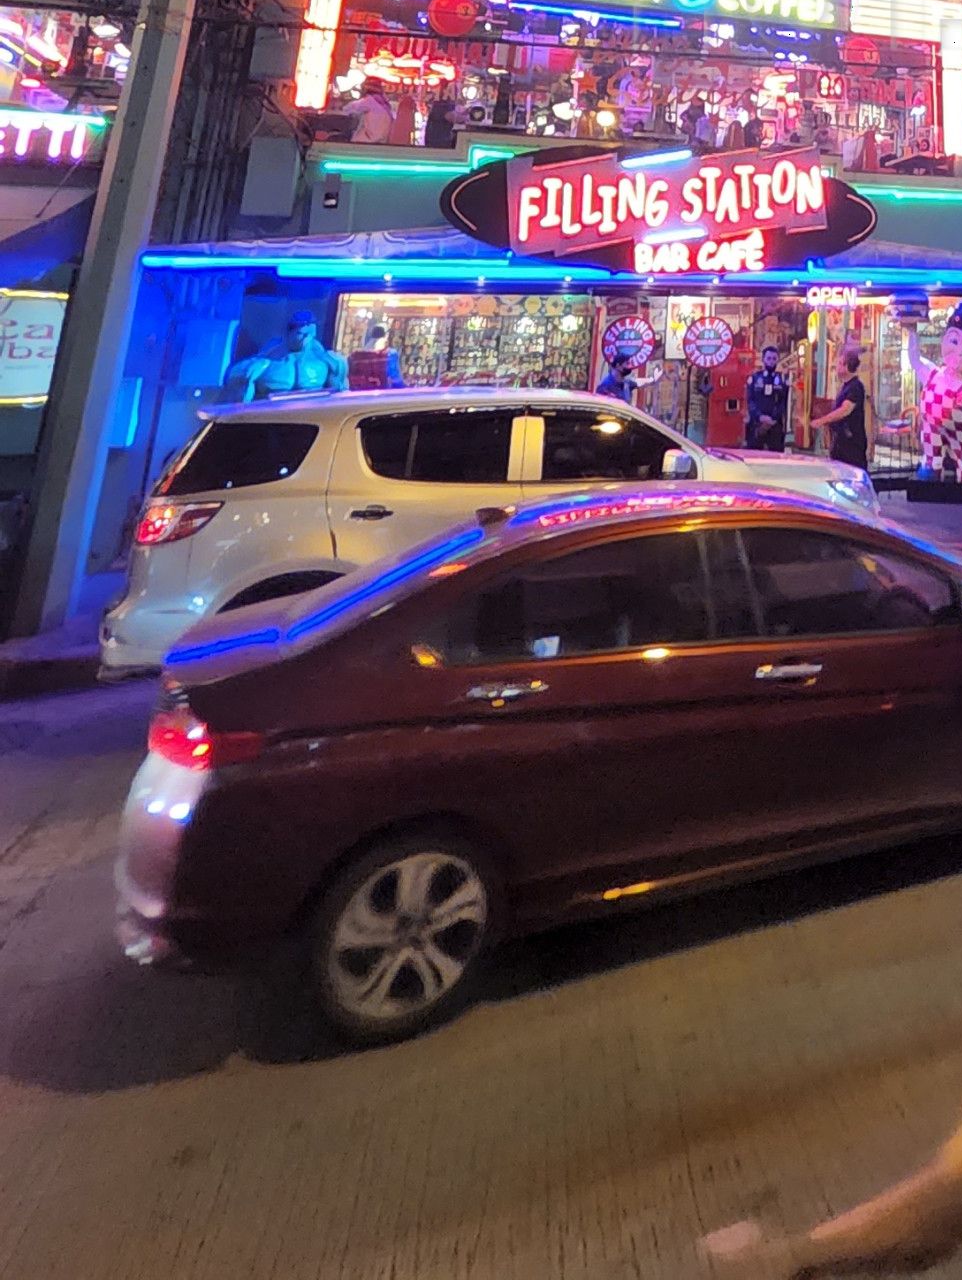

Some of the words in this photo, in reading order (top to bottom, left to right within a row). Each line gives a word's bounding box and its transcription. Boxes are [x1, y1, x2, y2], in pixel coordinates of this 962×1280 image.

[518, 172, 669, 242] FILLING
[680, 160, 823, 223] STATION
[634, 242, 690, 272] BAR
[697, 228, 765, 272] CAFÉ
[807, 286, 857, 307] OPEN
[605, 318, 653, 341] FILLING
[686, 318, 731, 341] FILLING
[685, 343, 731, 368] STATION
